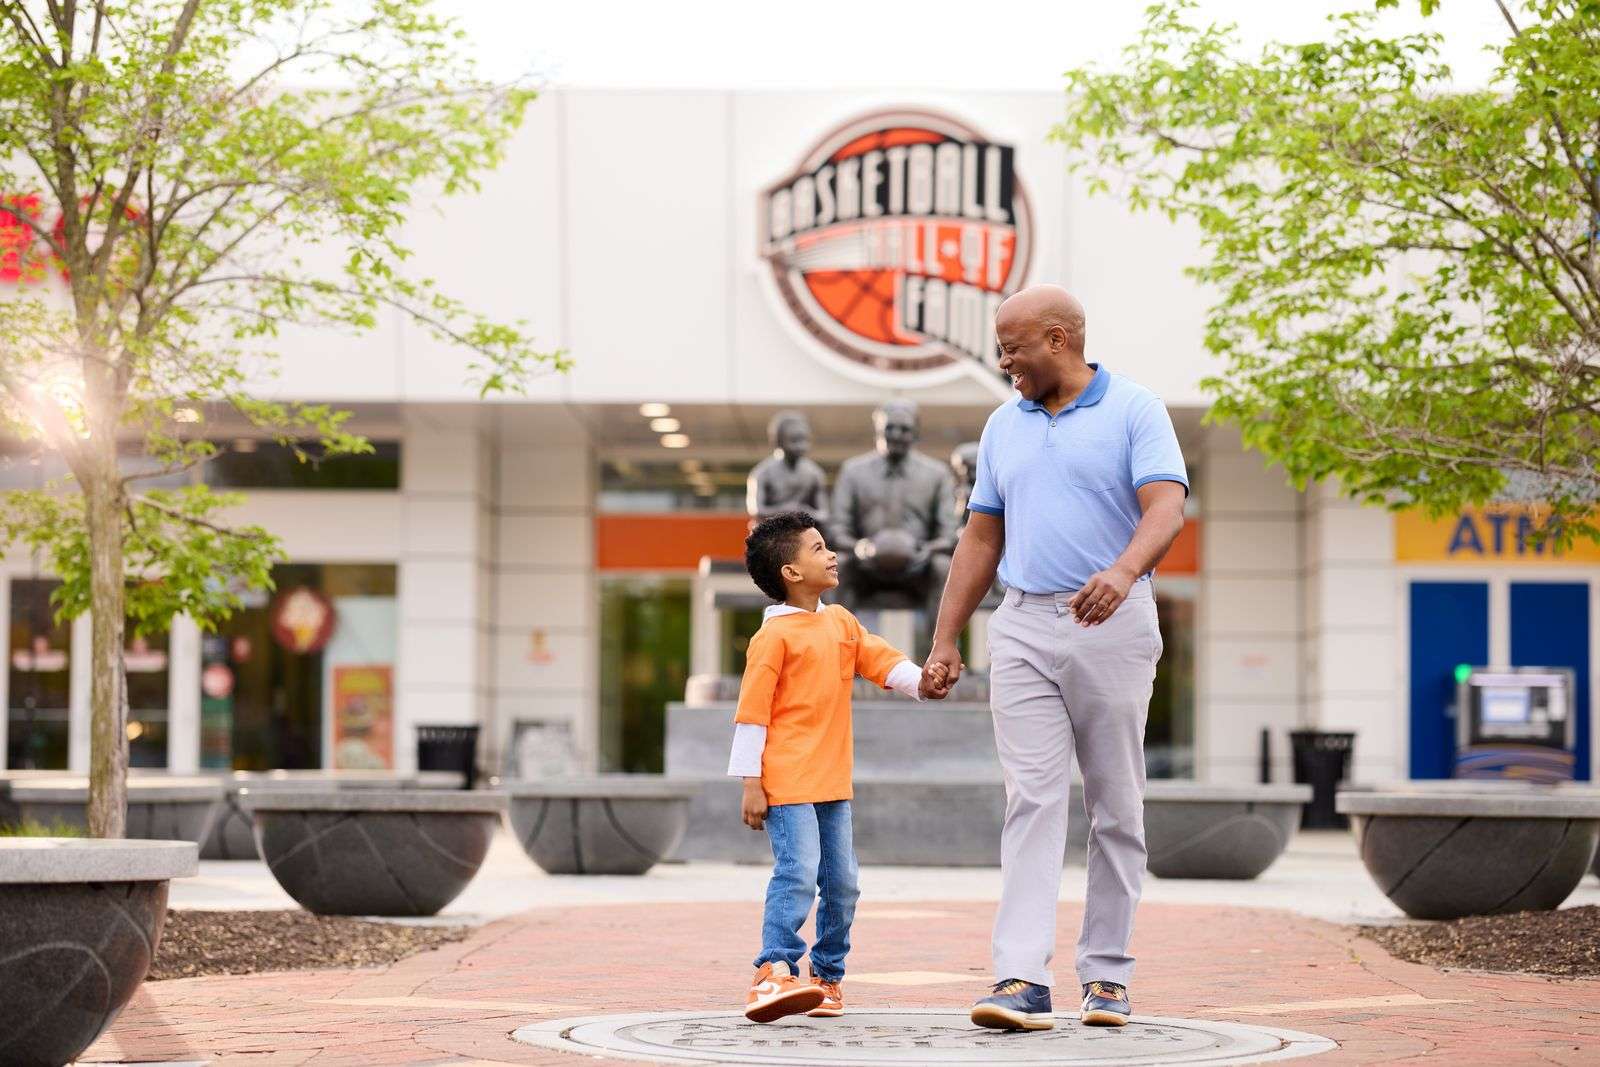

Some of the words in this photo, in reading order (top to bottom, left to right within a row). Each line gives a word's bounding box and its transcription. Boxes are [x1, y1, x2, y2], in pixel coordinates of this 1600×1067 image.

[769, 142, 1010, 241] BASKETBALL
[865, 220, 945, 275] HALL
[1449, 511, 1566, 555] ATM
